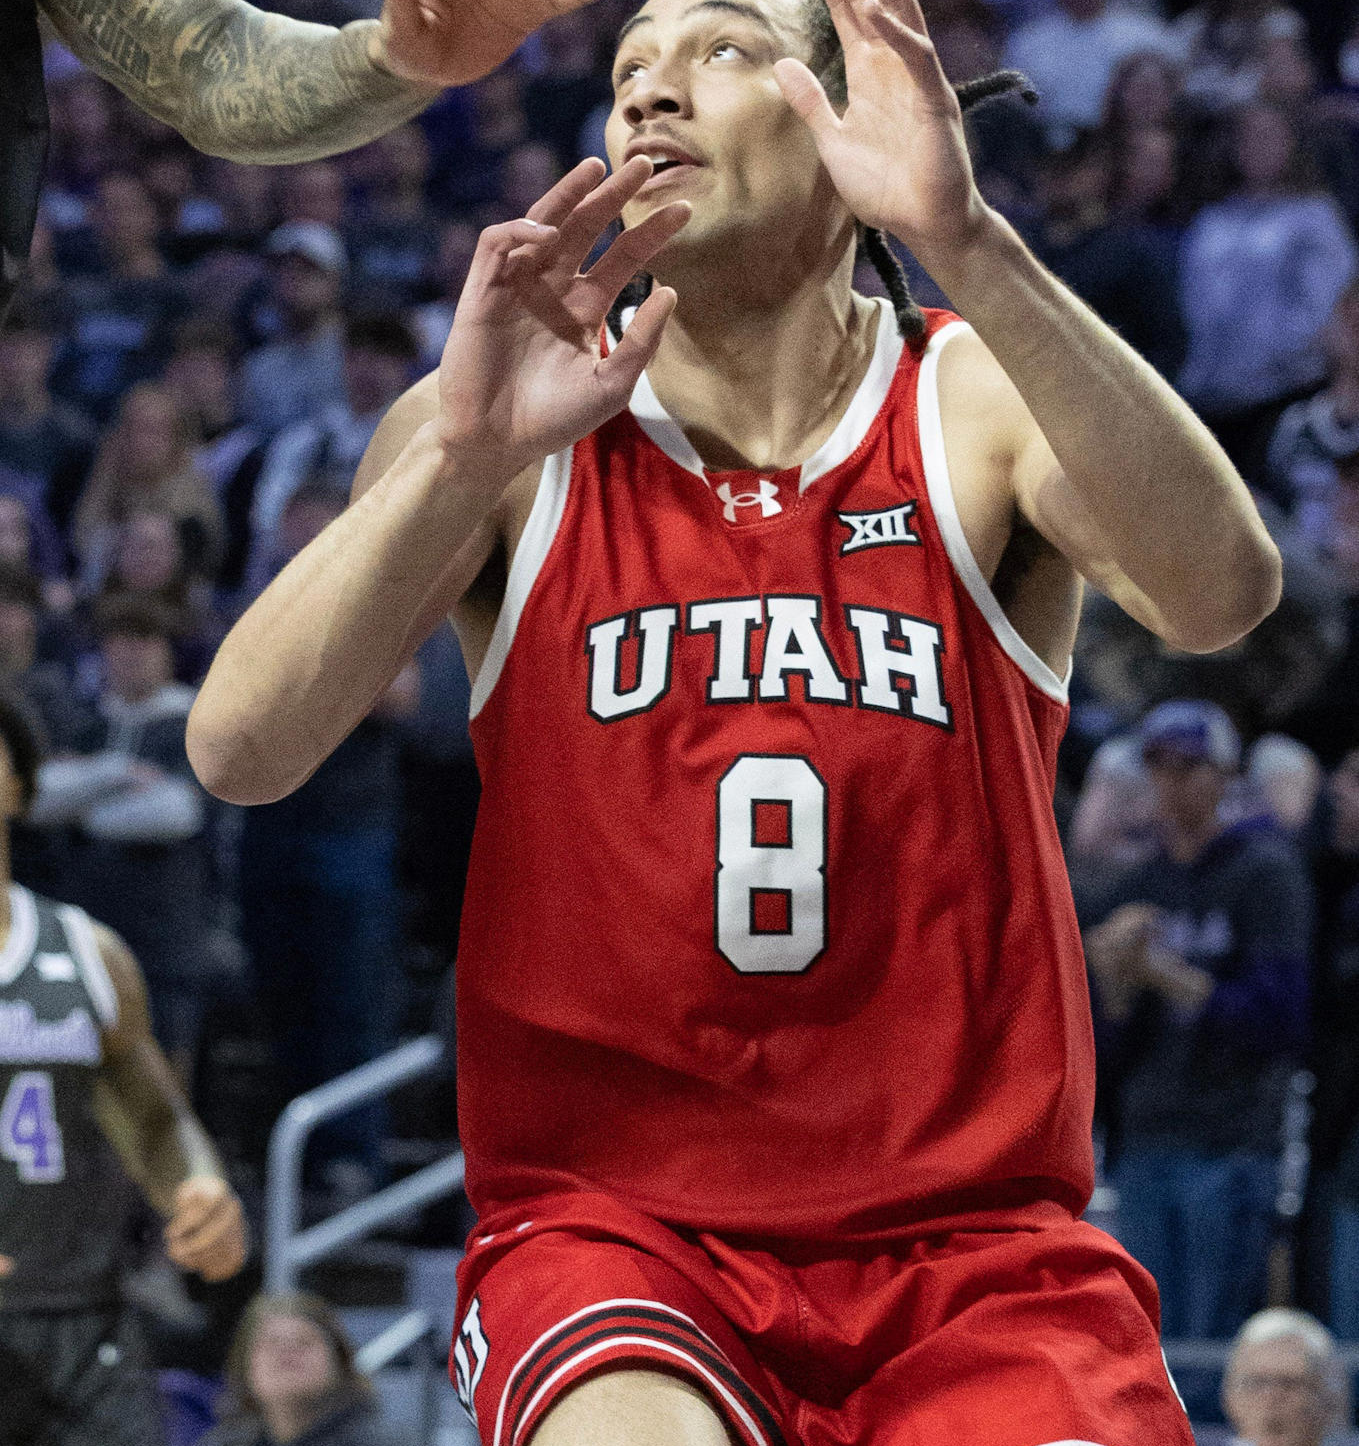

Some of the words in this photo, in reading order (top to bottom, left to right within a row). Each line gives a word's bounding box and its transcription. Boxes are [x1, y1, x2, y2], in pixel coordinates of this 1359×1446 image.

[836, 499, 923, 554] XII
[585, 593, 955, 732] UTAH
[713, 753, 828, 974] 8
